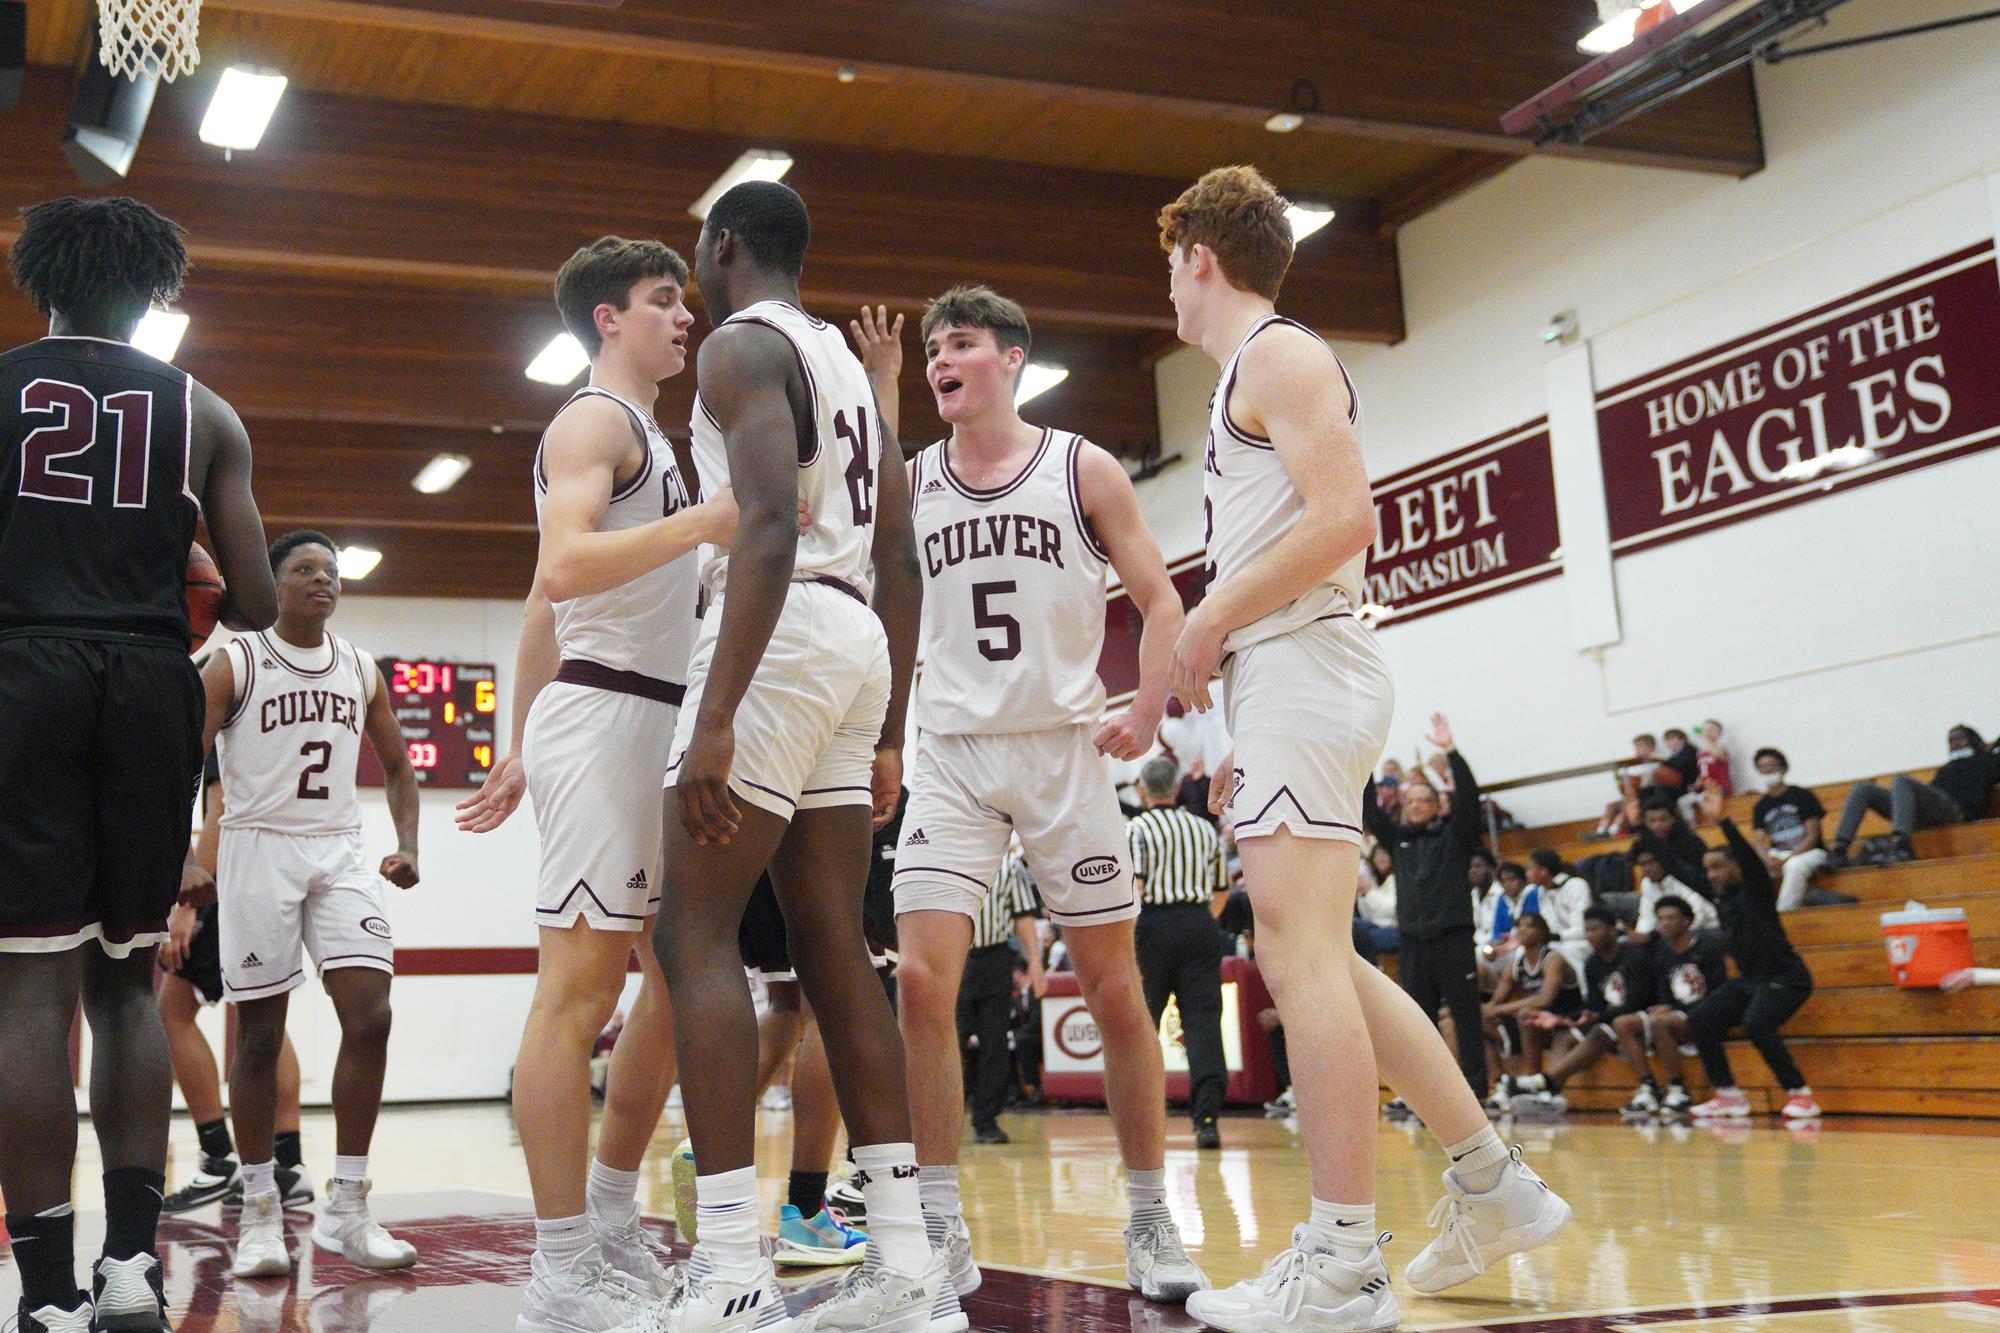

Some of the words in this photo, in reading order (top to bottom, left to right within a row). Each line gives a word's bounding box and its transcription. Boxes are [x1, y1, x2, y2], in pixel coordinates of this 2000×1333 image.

[1645, 361, 1766, 437] HOME
[1772, 335, 1831, 390] OF
[1838, 296, 1941, 366] THE
[18, 378, 153, 509] 21
[1651, 354, 1952, 516] EAGLES
[924, 514, 1065, 579] CULVER
[972, 580, 1022, 662] 5
[261, 690, 359, 735] CULVER
[444, 702, 455, 724] 1
[475, 681, 496, 713] 6
[297, 740, 332, 800] 2
[473, 745, 491, 768] 4
